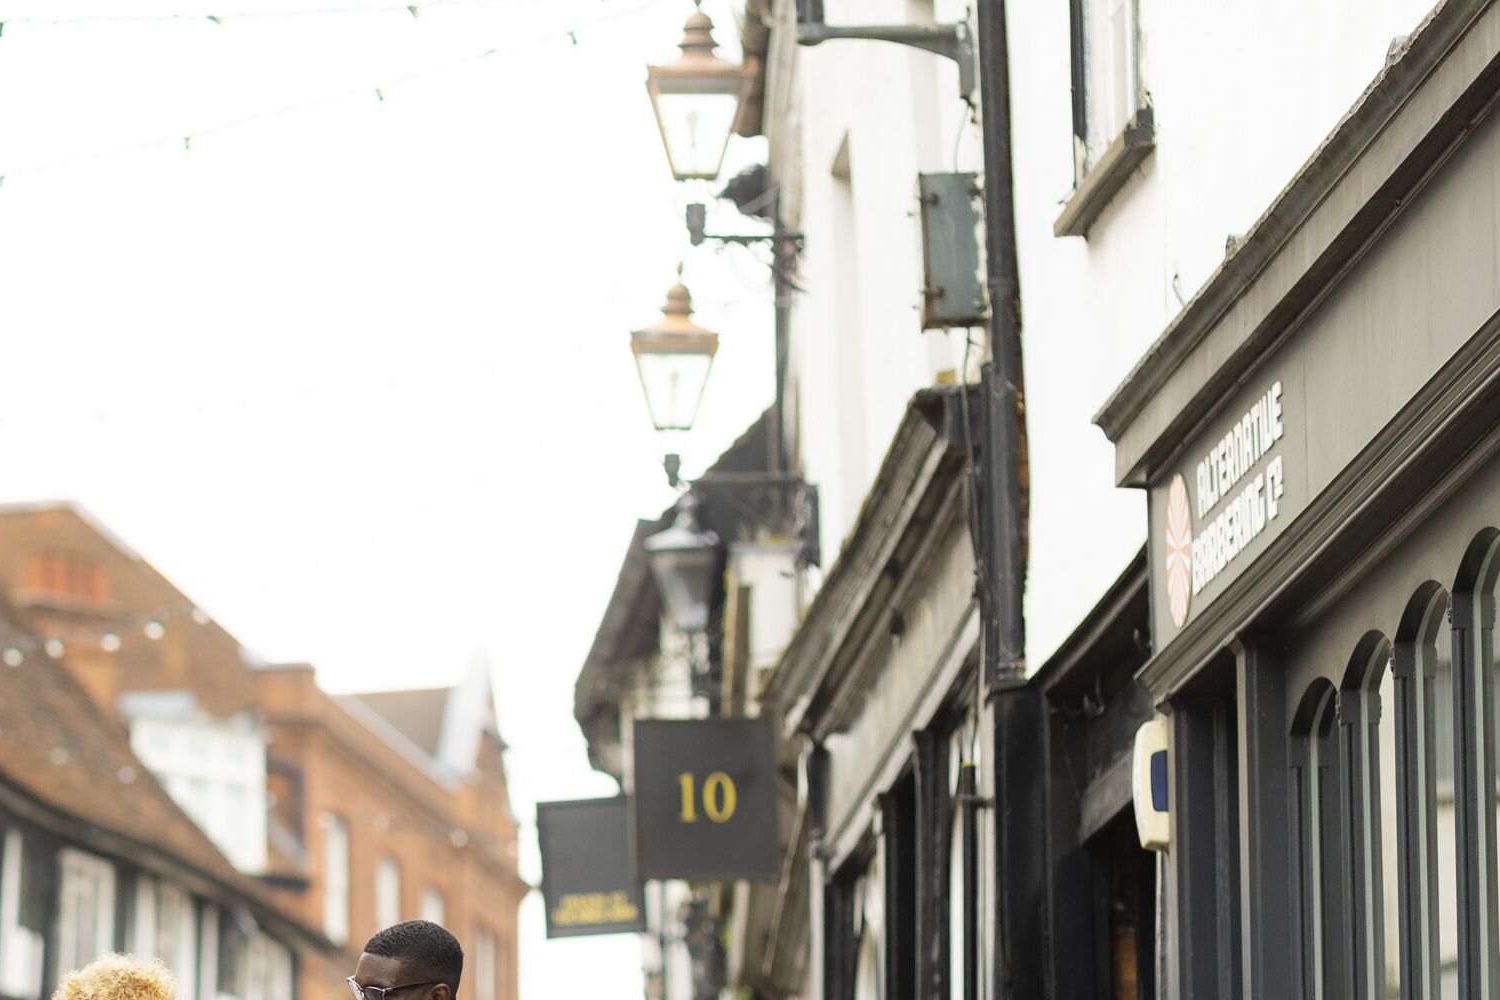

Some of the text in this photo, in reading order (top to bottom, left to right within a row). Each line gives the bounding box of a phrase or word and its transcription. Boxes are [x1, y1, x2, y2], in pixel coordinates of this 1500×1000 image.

[1197, 381, 1283, 520] ALTERNATIVE
[1191, 473, 1267, 597] BARBERING
[677, 770, 738, 825] 10
